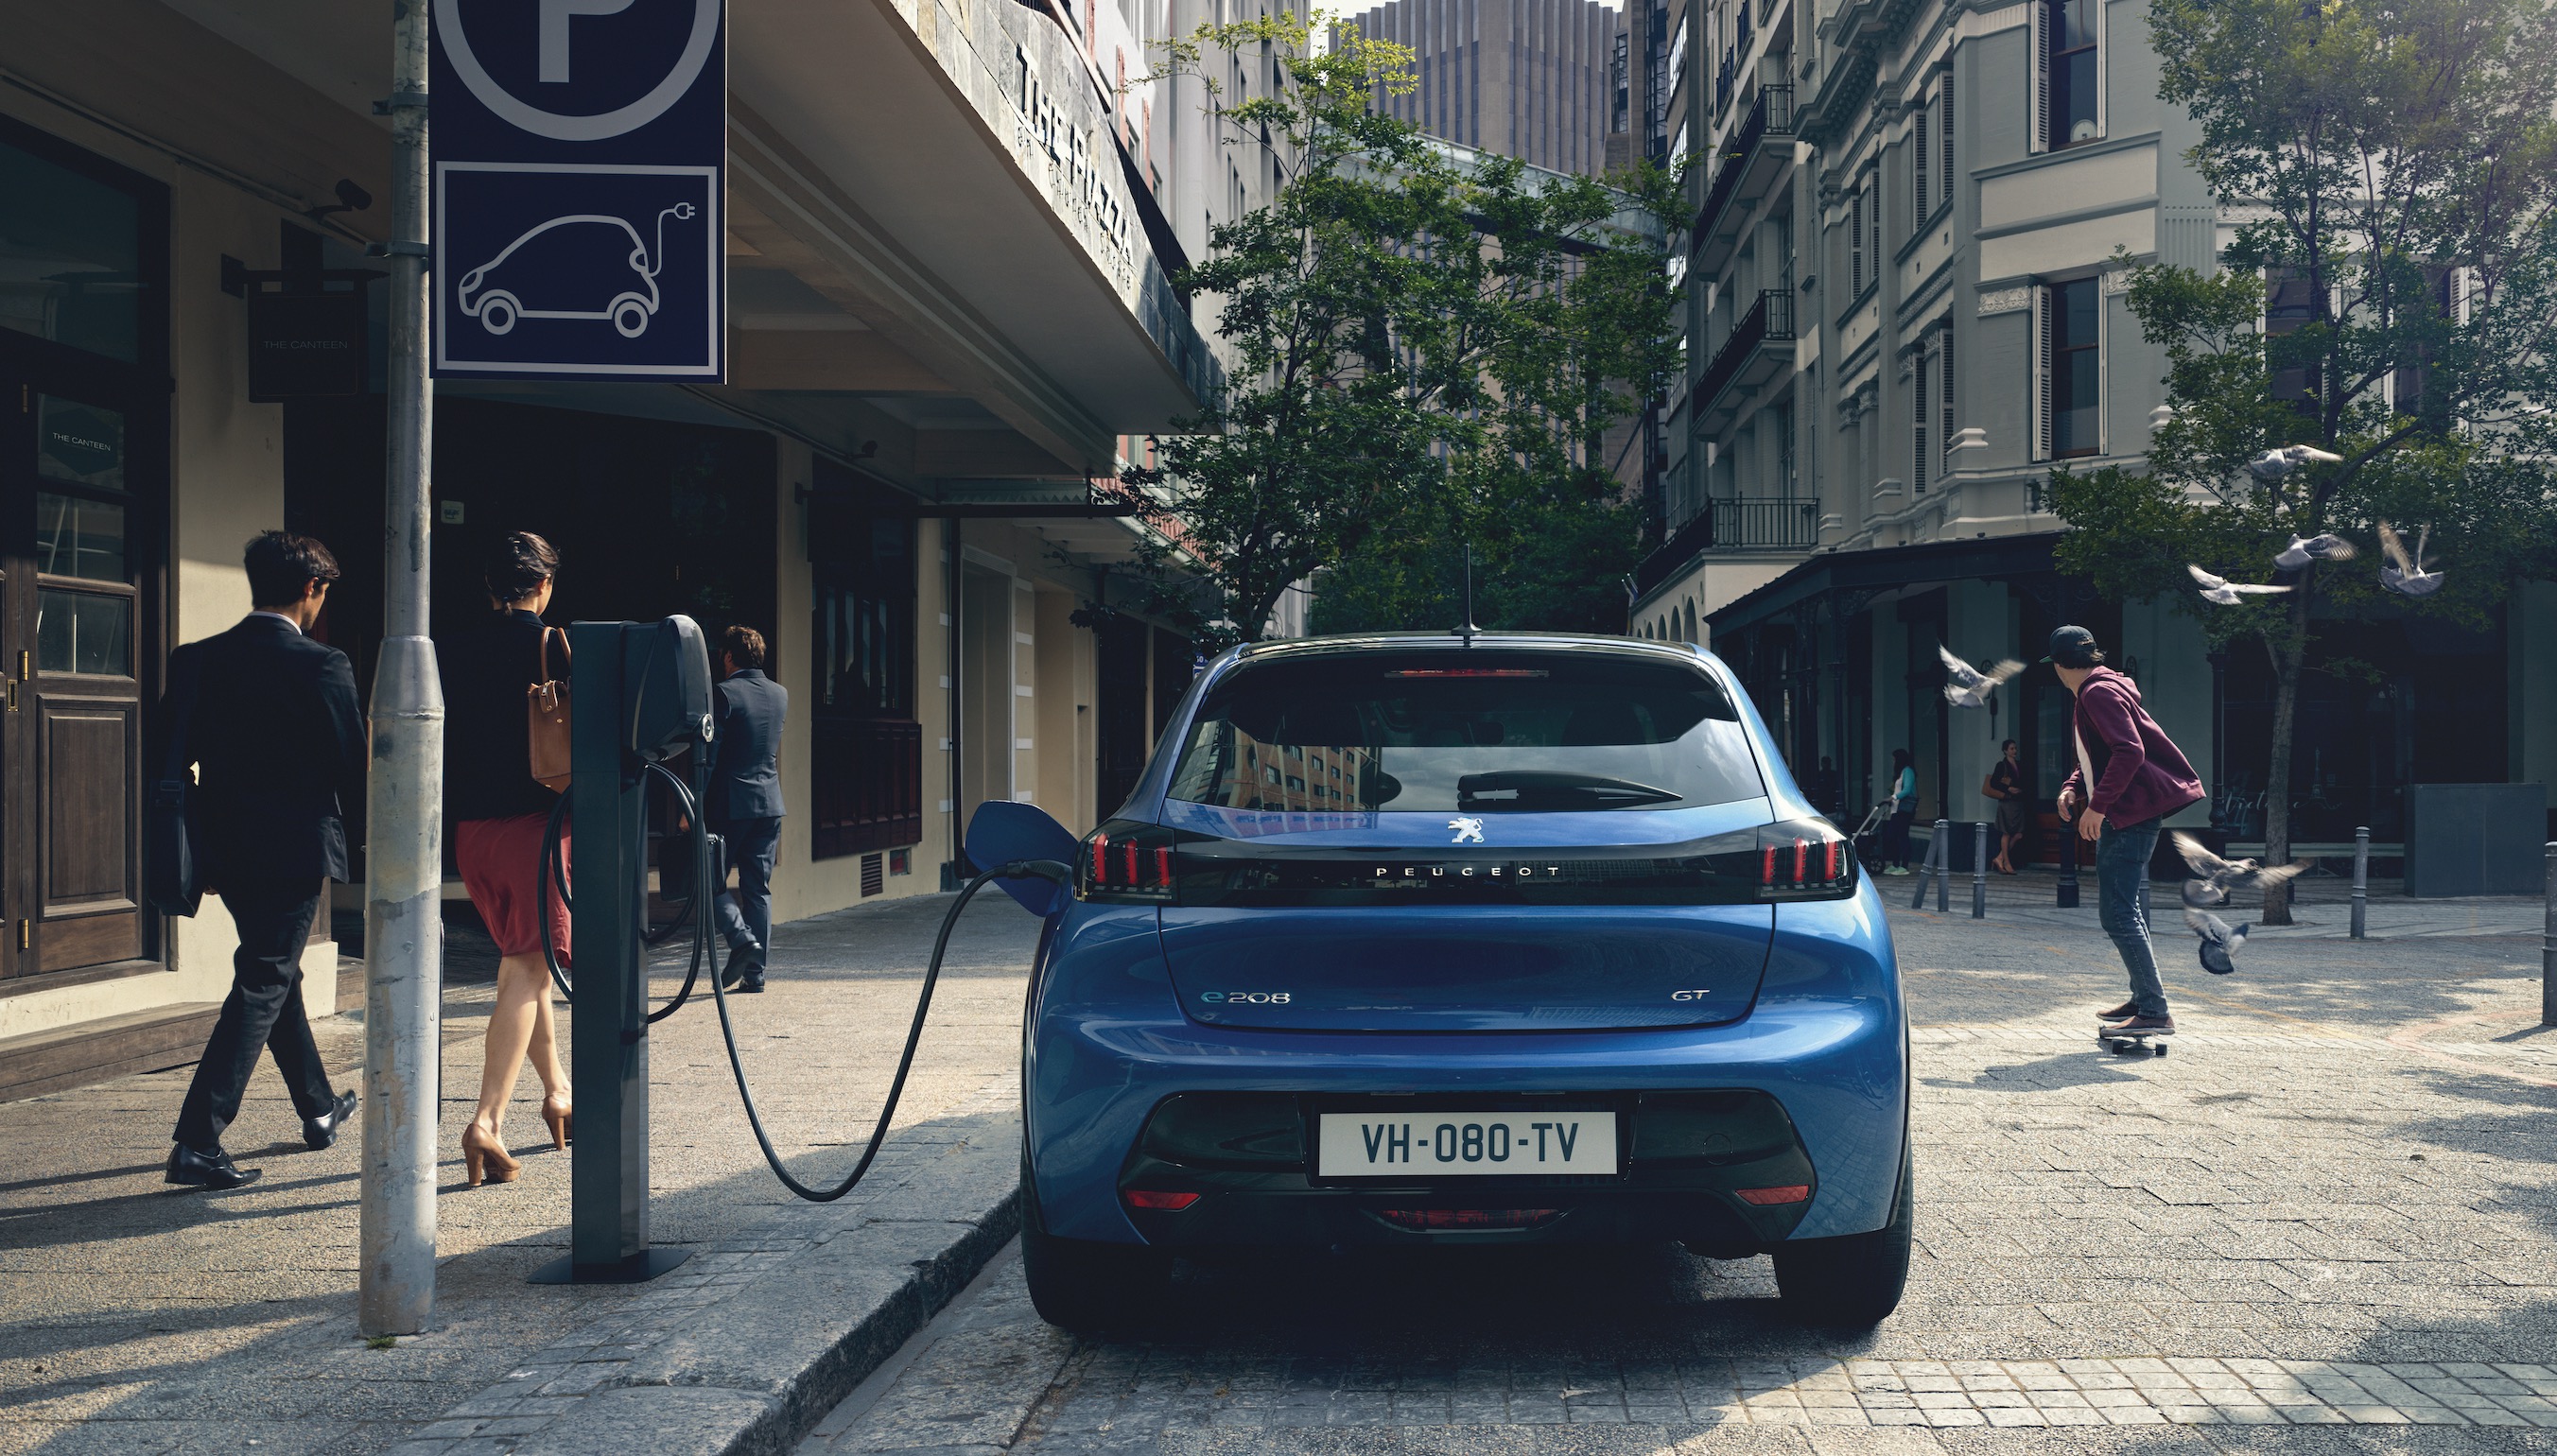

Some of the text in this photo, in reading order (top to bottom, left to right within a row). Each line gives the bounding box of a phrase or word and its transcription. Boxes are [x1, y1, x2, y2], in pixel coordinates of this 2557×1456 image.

[1021, 41, 1072, 165] THE
[1073, 121, 1137, 271] PIAZZA
[264, 340, 348, 349] THE CANTEEN
[52, 432, 70, 442] THE
[71, 436, 111, 452] CANTEEN
[1376, 867, 1558, 877] PEUGEOT
[1671, 990, 1711, 1001] GT
[1361, 1122, 1578, 1163] VH-080-TV
